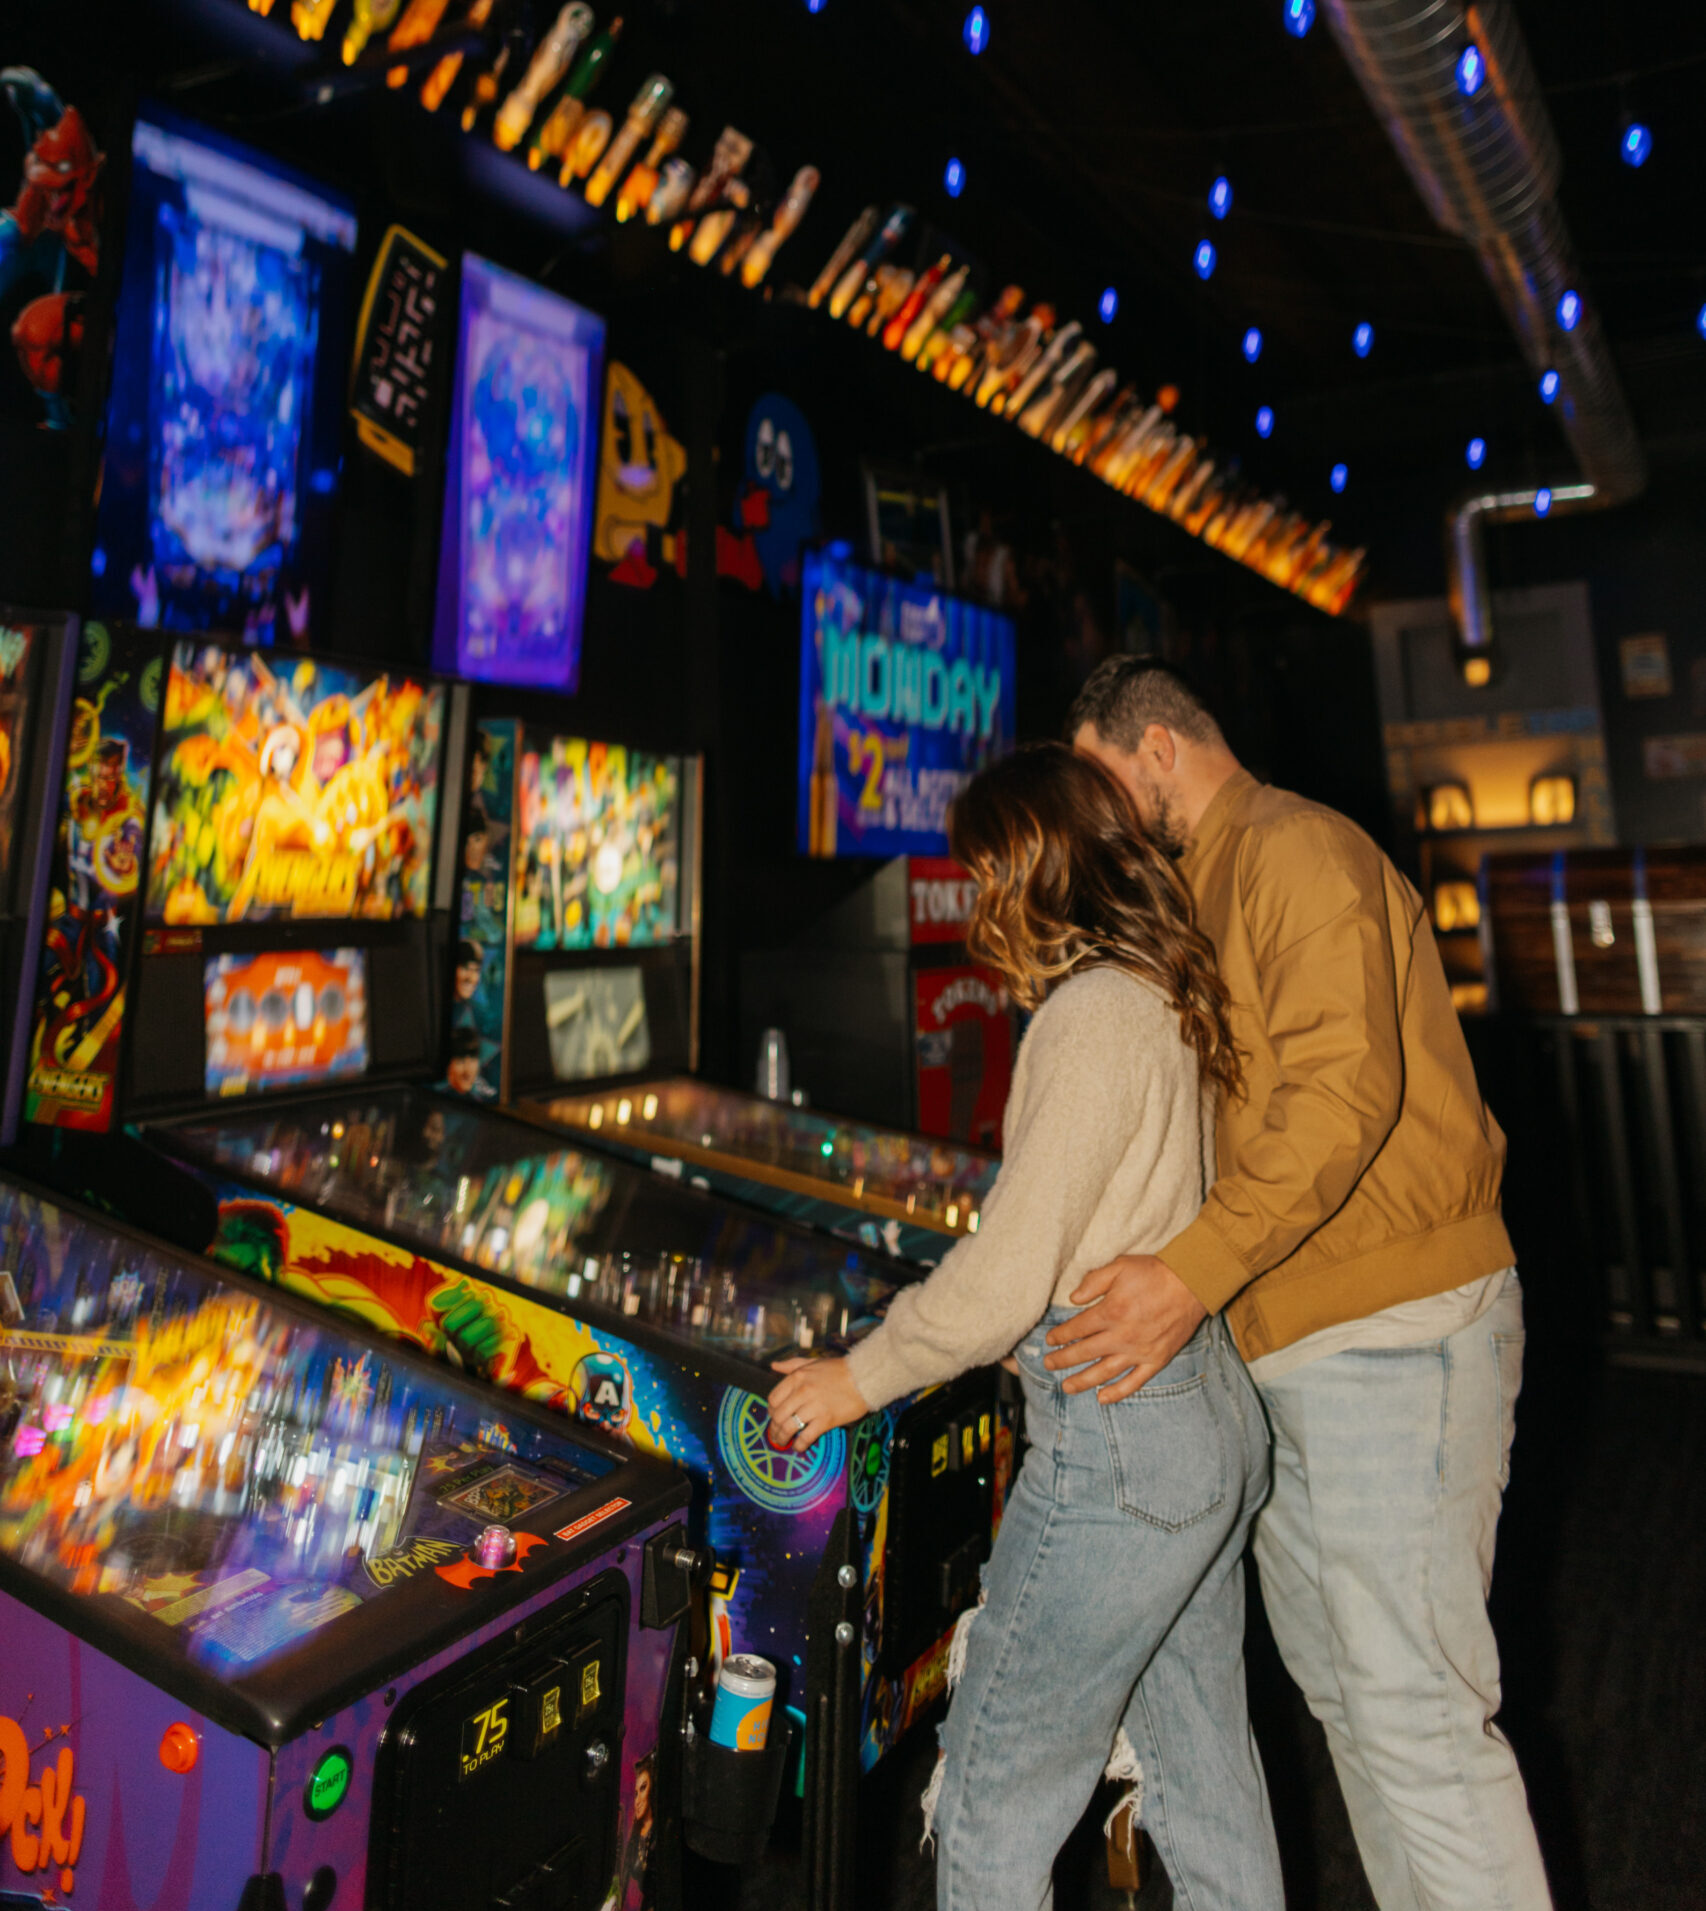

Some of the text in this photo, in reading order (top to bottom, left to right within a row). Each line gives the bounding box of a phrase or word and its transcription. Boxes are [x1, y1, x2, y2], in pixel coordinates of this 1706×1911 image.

[822, 624, 1000, 736] MONDAY
[594, 1380, 620, 1407] A
[366, 1537, 461, 1585] BATMAN
[463, 1739, 505, 1775] TO PLAY
[315, 1767, 347, 1799] START
